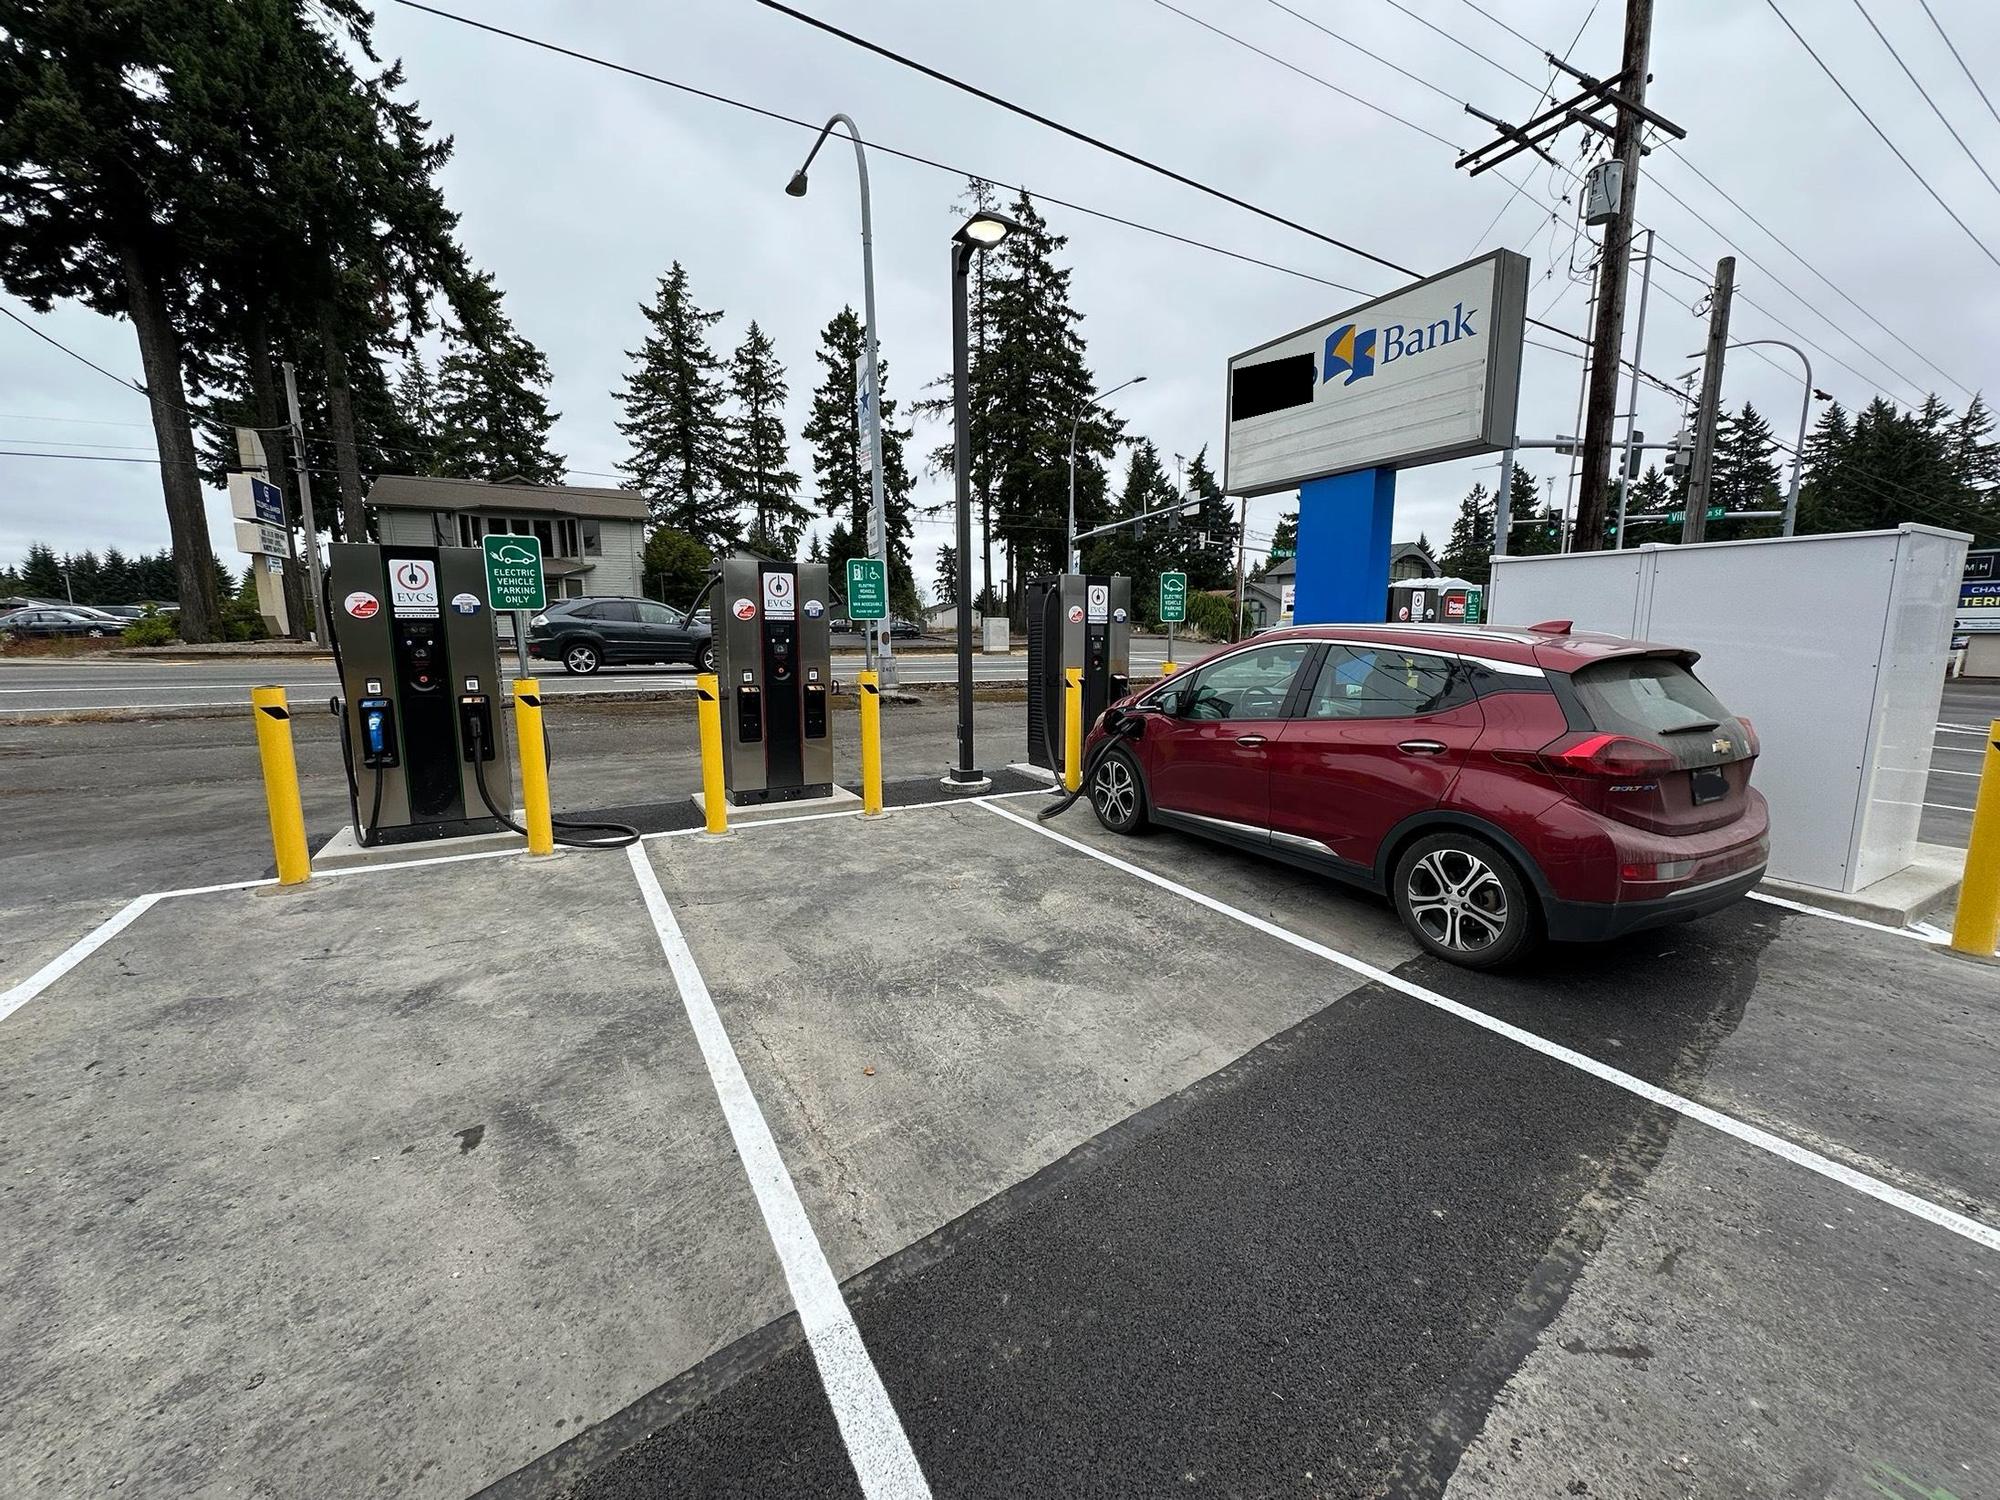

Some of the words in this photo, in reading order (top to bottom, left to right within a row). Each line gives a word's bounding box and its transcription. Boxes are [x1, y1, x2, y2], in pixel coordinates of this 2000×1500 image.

[1381, 302, 1478, 365] Bank
[1672, 510, 1686, 522] Vill
[493, 568, 536, 576] ELECTRIC
[497, 577, 535, 585] VEHICLE
[497, 586, 536, 595] PARKING
[397, 592, 434, 602] EVCS
[505, 595, 529, 603] ONLY
[767, 599, 793, 608] EVCS
